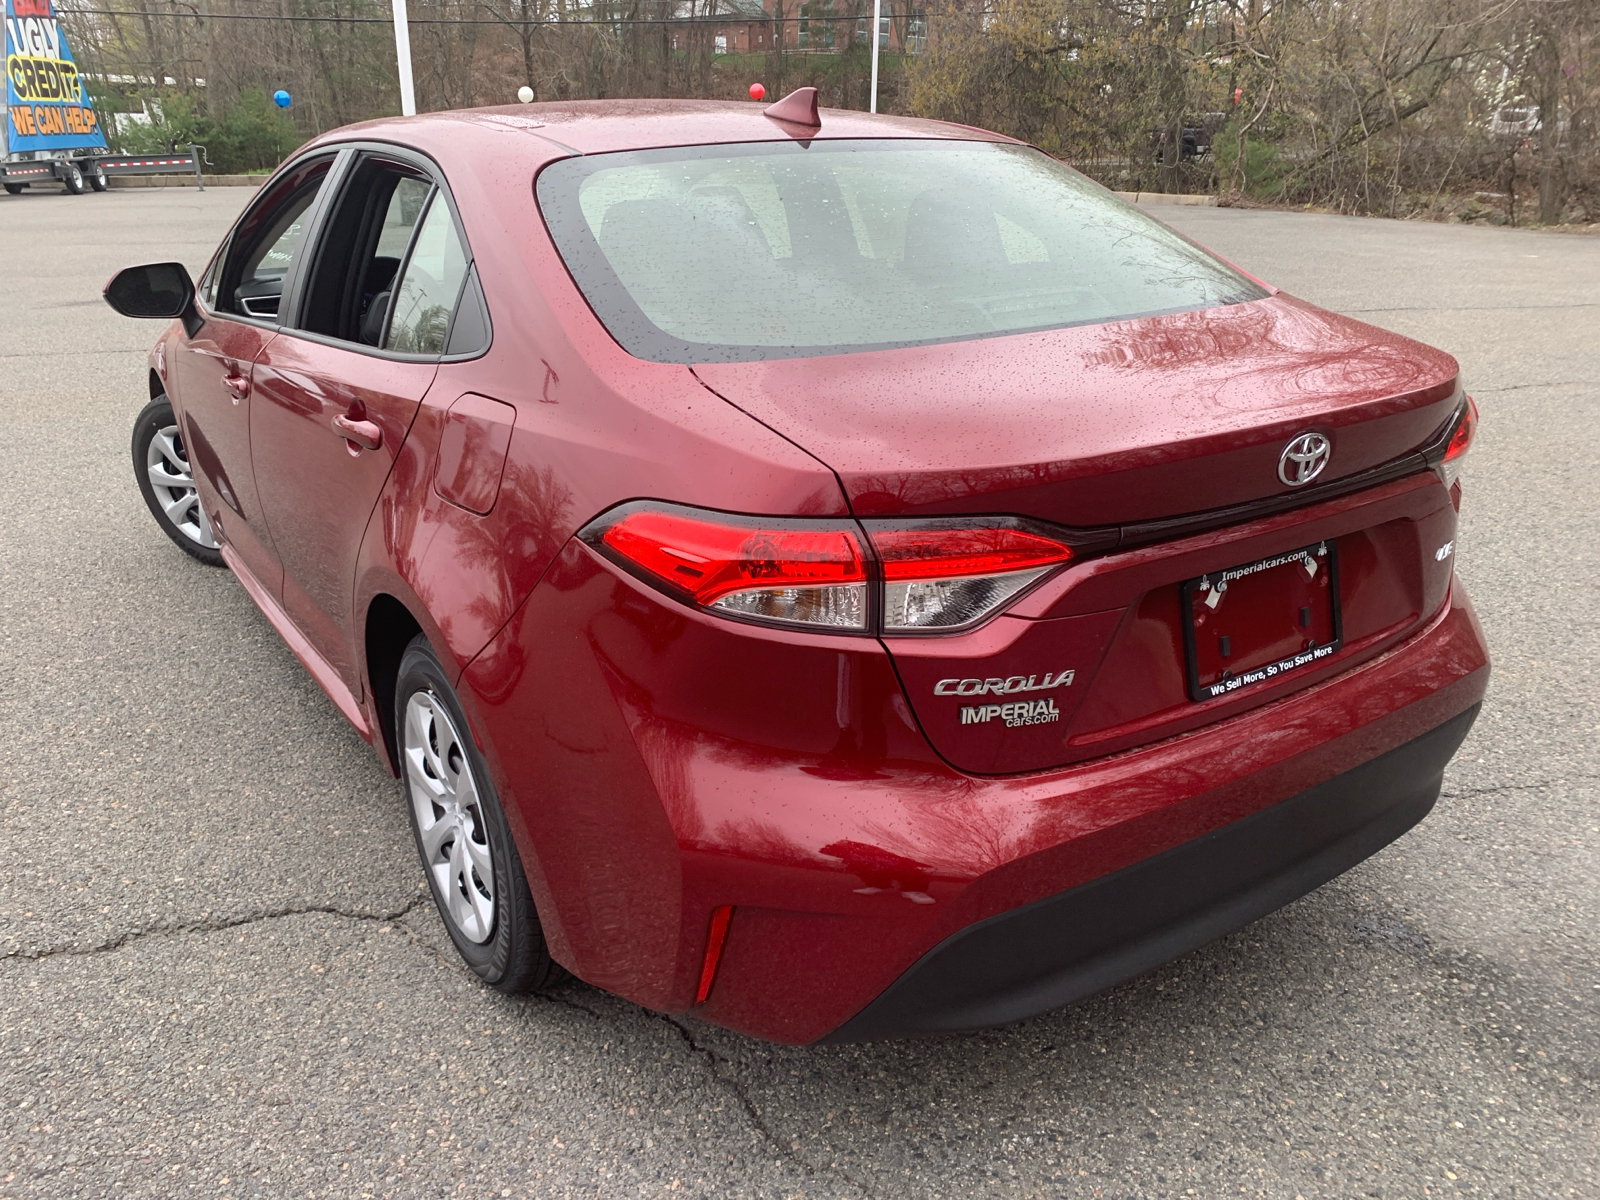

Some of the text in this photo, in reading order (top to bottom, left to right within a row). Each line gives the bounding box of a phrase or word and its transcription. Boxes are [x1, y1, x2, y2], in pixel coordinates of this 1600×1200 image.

[6, 17, 60, 60] UGLY
[9, 56, 80, 101] CREDIT?
[9, 105, 98, 136] WE CAN HELP!
[1221, 550, 1308, 580] Imperialcars.com
[933, 669, 1076, 696] COROLLA
[1210, 646, 1333, 696] We Sell More, So You Save More
[960, 698, 1060, 724] IMPERIAL
[1005, 713, 1059, 728] cars.com
[493, 868, 510, 969] YOKOHAMA
